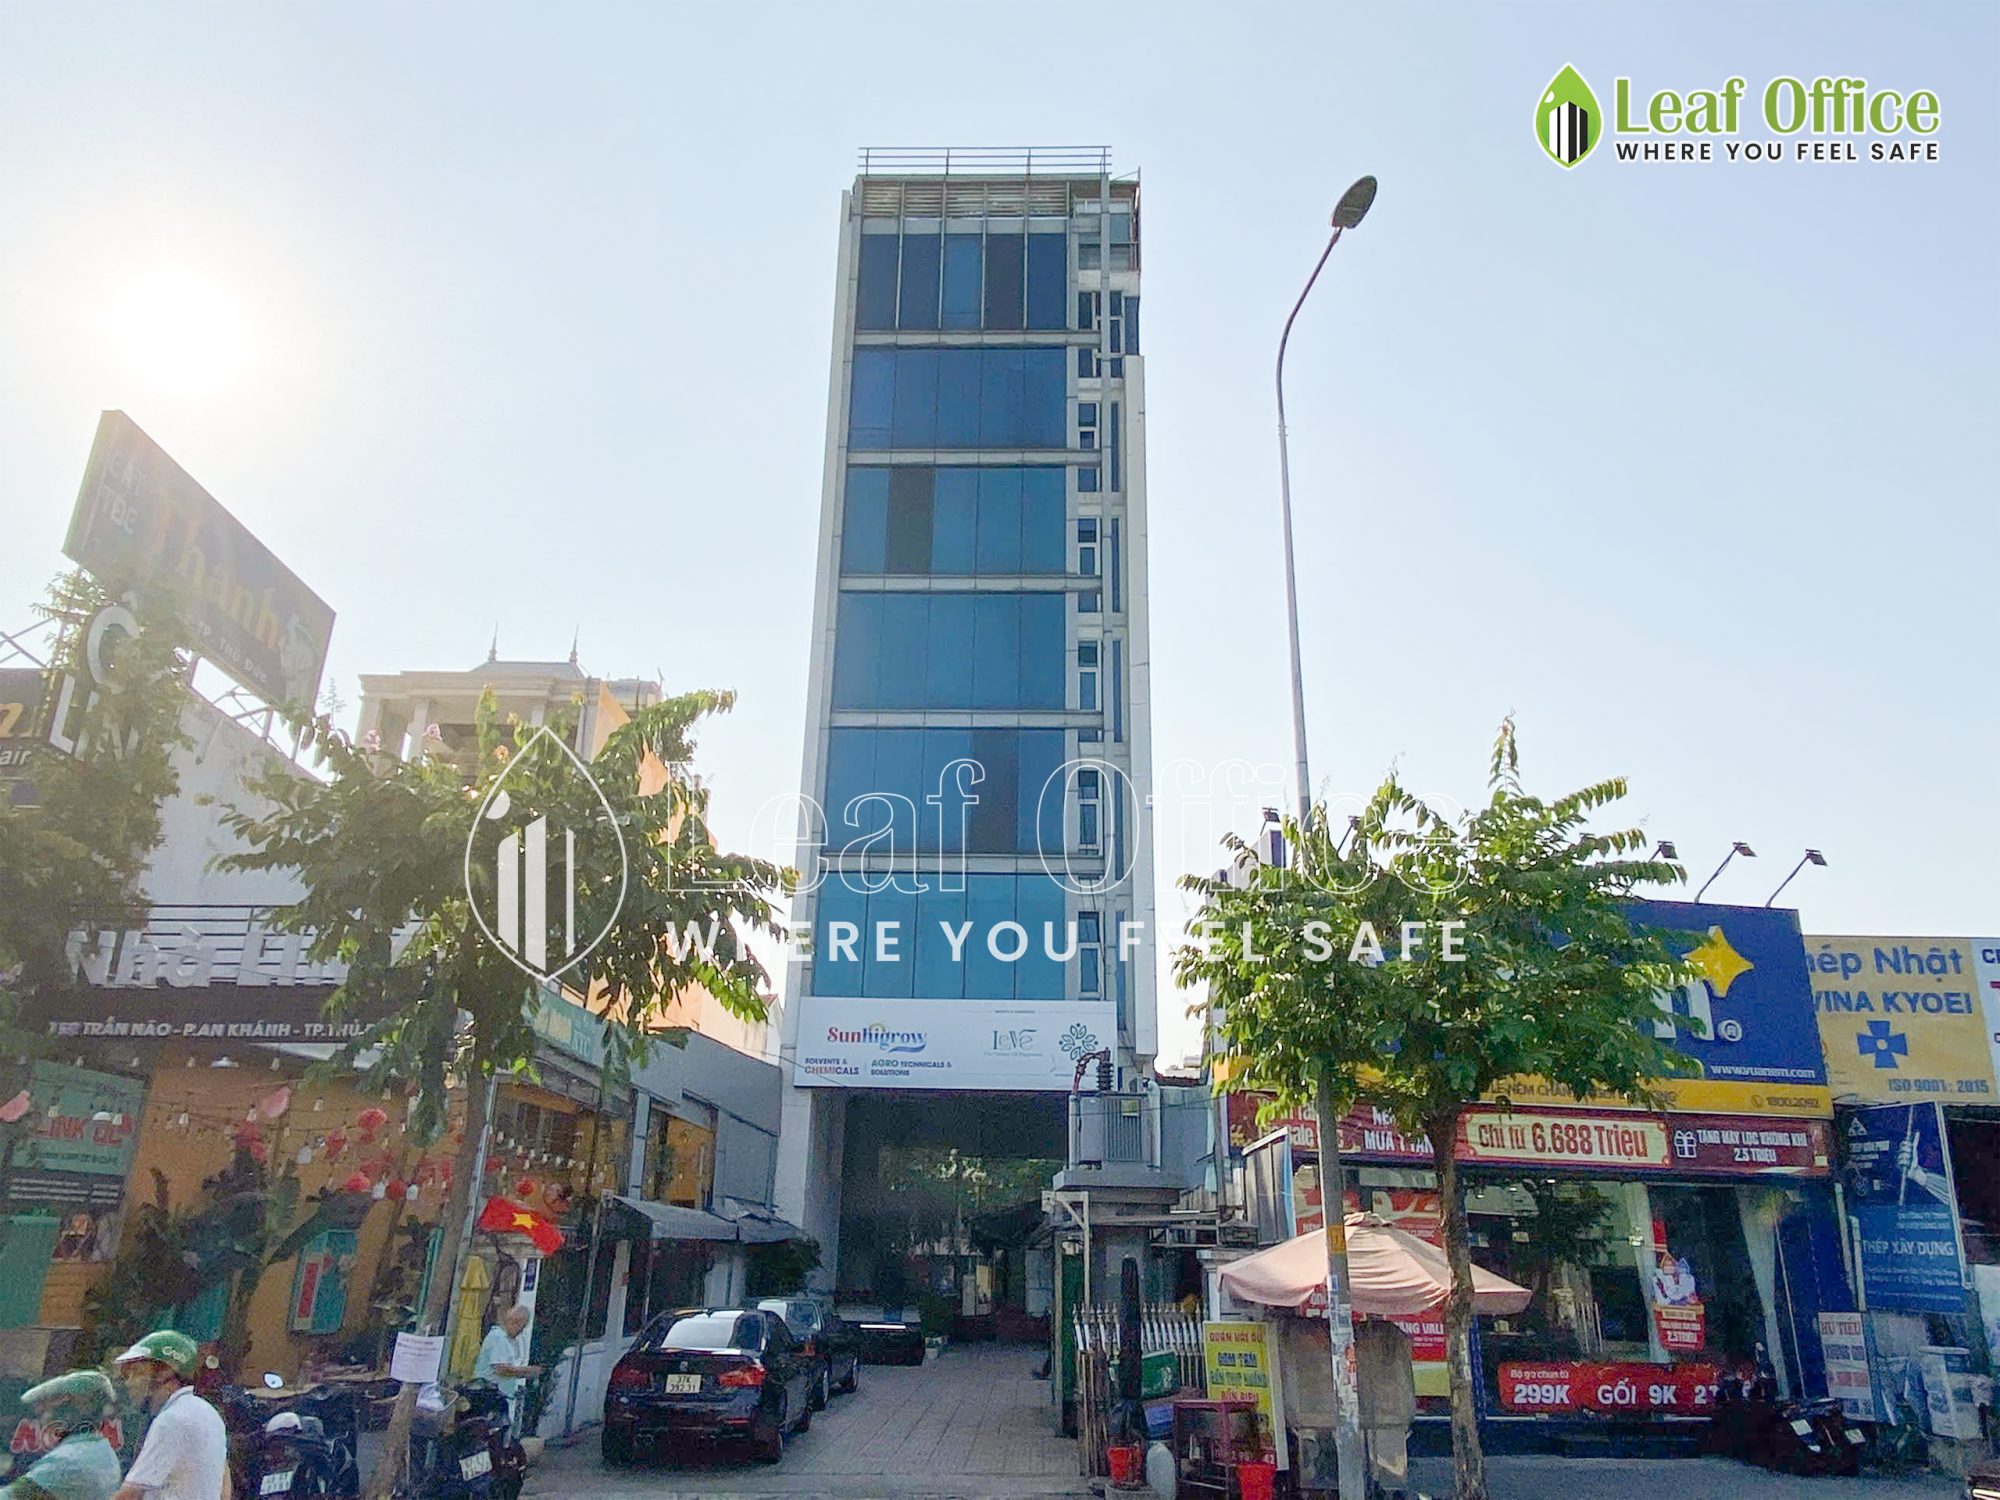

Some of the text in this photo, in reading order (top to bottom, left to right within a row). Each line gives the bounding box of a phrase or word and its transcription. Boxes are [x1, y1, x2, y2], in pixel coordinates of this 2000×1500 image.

[1873, 945, 1963, 983] Nhật
[1881, 991, 1973, 1014] KYOEI
[227, 1019, 292, 1037] KHÁNH
[826, 1023, 928, 1052] Sunhigrow
[804, 1065, 860, 1076] CHEMICALS
[871, 1058, 899, 1068] AGRO
[1531, 1121, 1594, 1155] 6.688
[1513, 1383, 1571, 1405] 299K
[1597, 1377, 1637, 1405] GỐI
[1649, 1384, 1678, 1405] 9K
